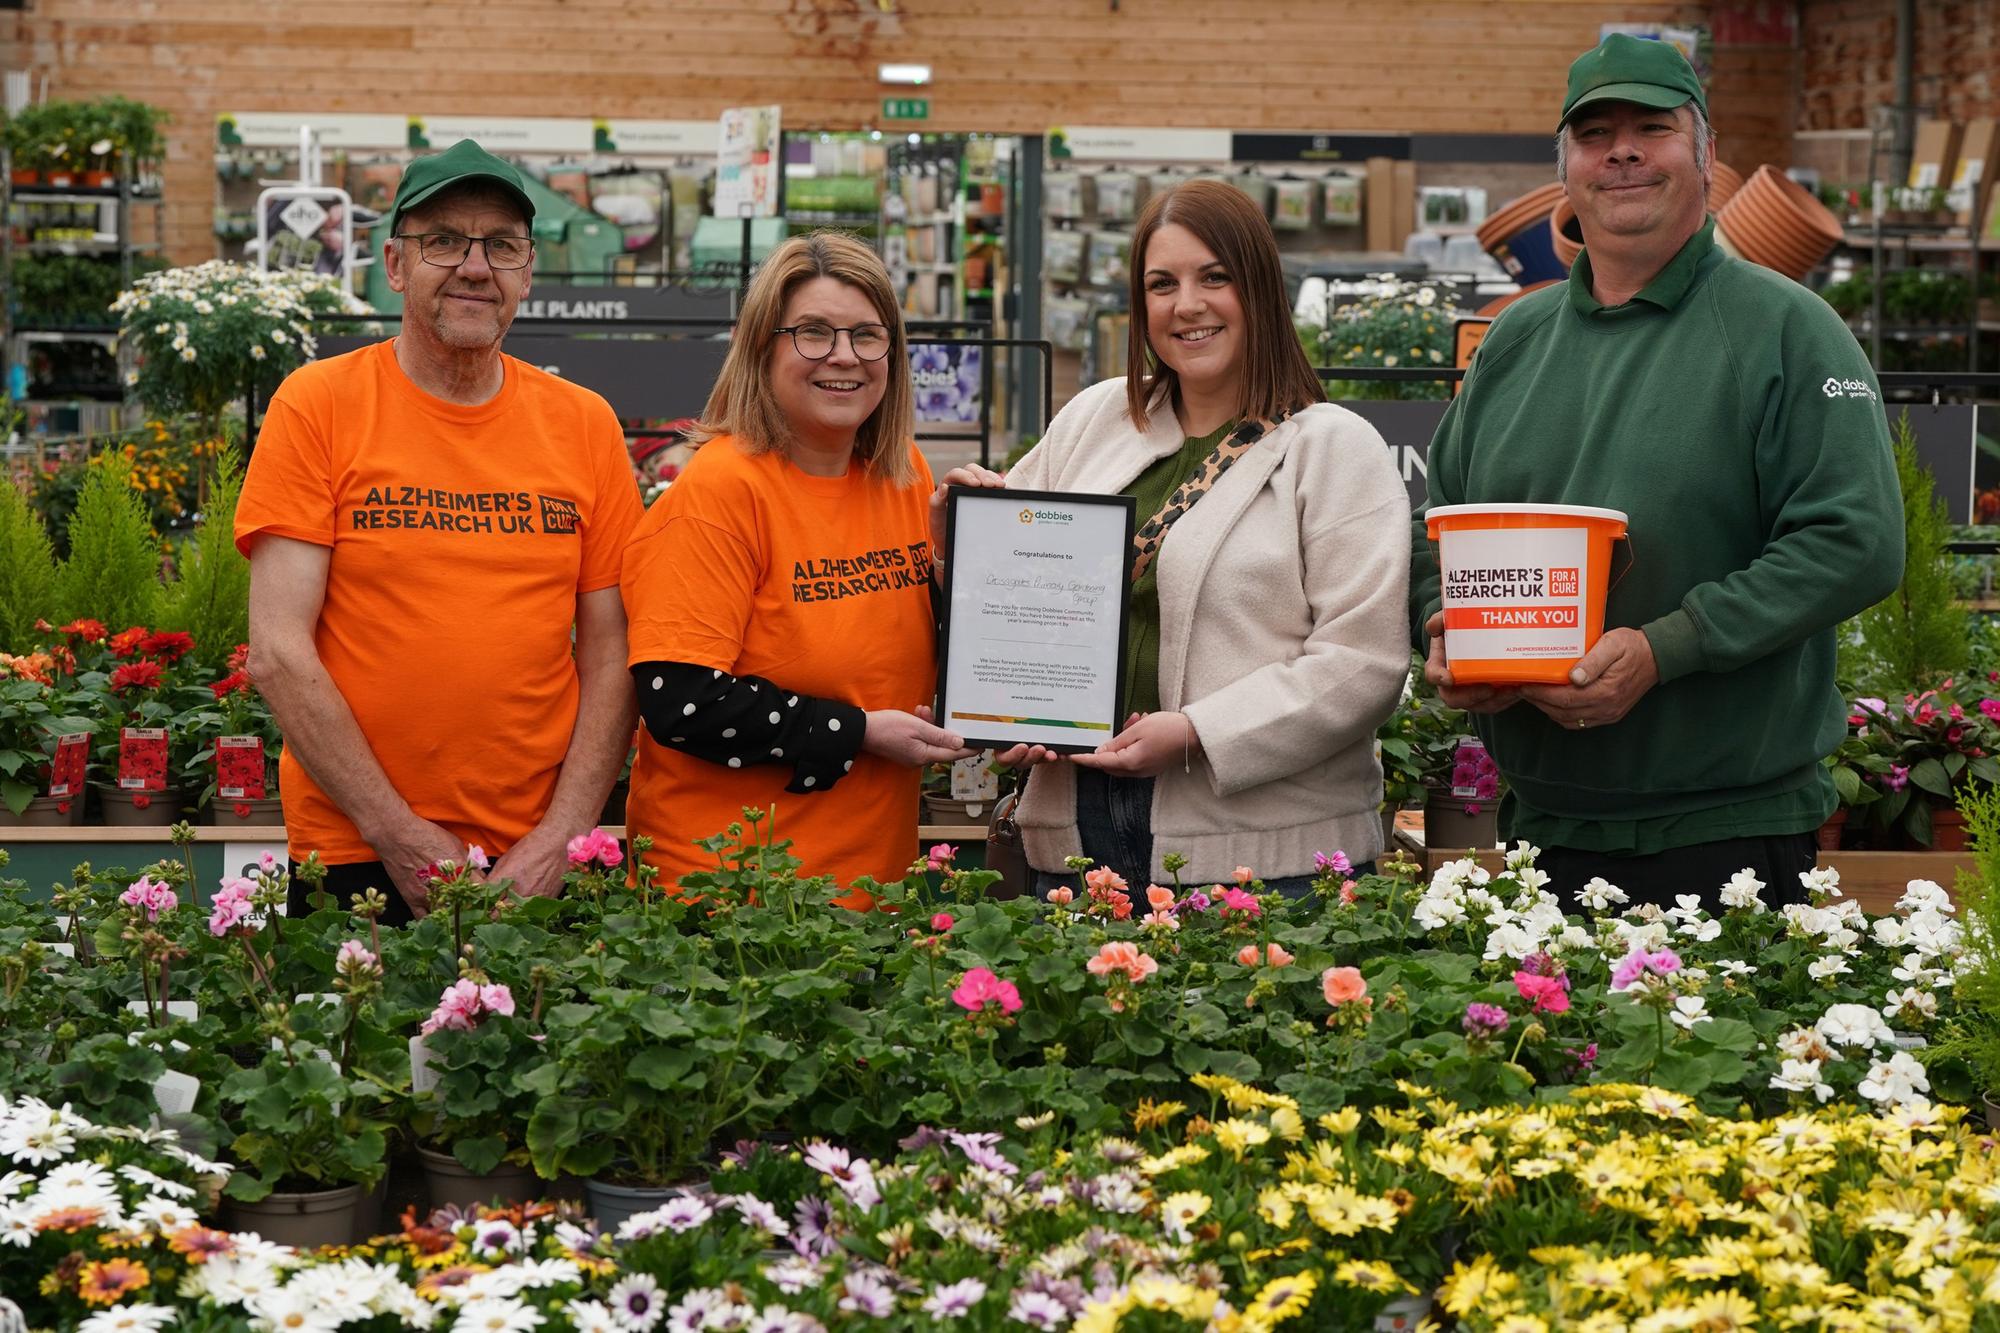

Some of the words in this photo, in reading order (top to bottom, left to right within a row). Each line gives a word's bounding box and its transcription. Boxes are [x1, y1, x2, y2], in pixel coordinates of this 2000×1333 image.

[516, 300, 545, 318] LE
[548, 300, 628, 319] PLANTS
[364, 486, 532, 512] ALZHEIMER'S
[352, 508, 492, 534] RESEARCH
[498, 515, 535, 534] UK
[1035, 510, 1073, 521] dobbies
[911, 547, 927, 564] OR
[1013, 549, 1064, 560] Congratulations
[1448, 568, 1544, 583] ALZHEIMER'S
[1552, 571, 1568, 582] FOR
[1570, 571, 1577, 582] A
[792, 573, 892, 603] RESEARCH
[891, 569, 917, 590] UK
[1446, 584, 1515, 599] RESEARCH
[1520, 584, 1544, 597] UK
[1552, 582, 1577, 593] CURE
[1481, 610, 1538, 625] THANK
[1543, 610, 1575, 624] YOU
[989, 678, 1021, 686] championing
[1041, 681, 1054, 689] living
